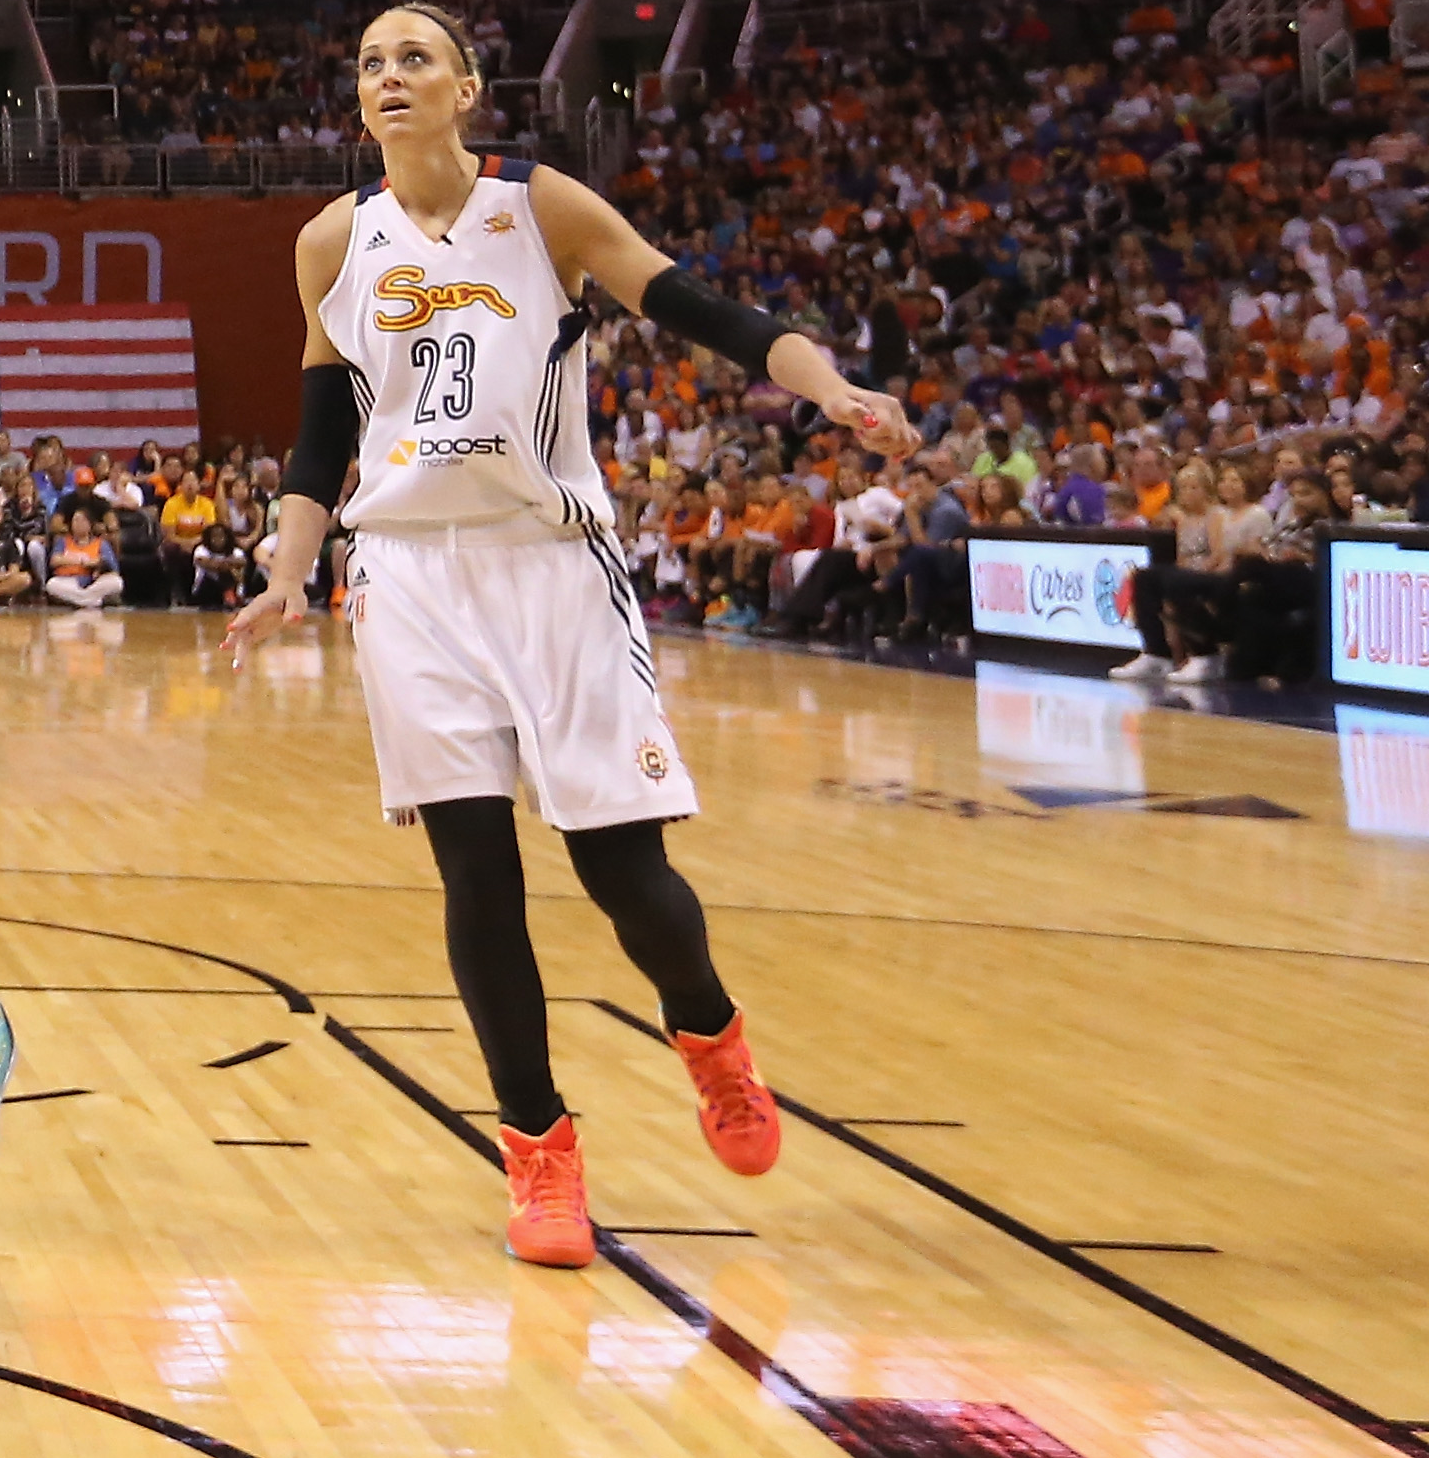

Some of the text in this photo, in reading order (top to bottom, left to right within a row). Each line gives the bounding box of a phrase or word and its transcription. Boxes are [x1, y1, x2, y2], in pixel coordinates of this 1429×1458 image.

[374, 265, 516, 332] Sun
[410, 332, 476, 426] 23
[419, 435, 507, 456] boost
